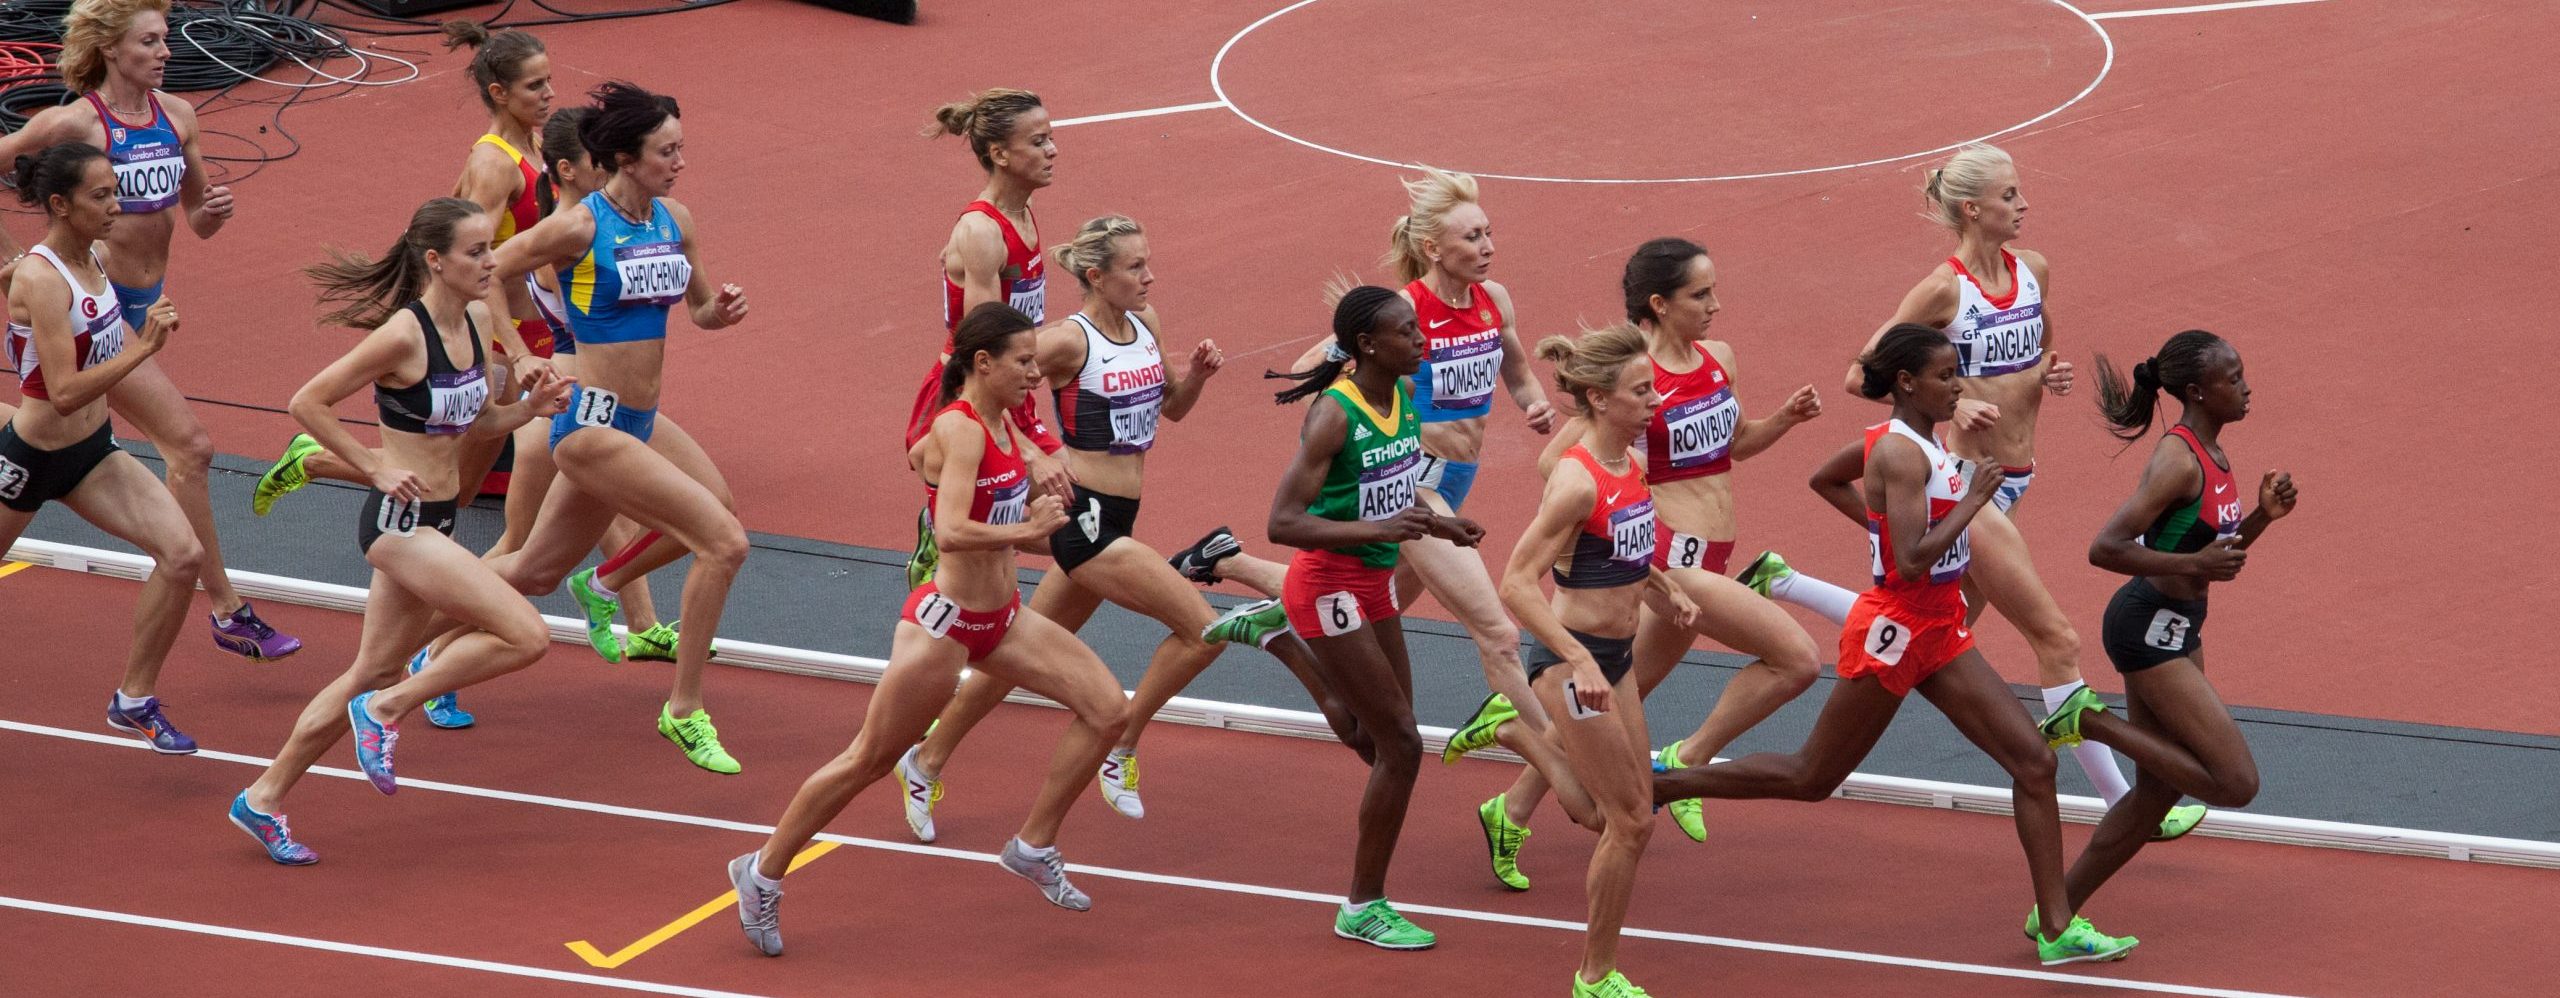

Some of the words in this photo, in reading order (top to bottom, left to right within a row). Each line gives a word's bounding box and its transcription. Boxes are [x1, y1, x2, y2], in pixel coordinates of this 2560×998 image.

[128, 151, 154, 160] London
[155, 148, 170, 157] 2012
[633, 248, 656, 257] London
[657, 245, 672, 253] 2012
[1995, 311, 2019, 324] London
[2020, 307, 2034, 318] 2012
[1452, 346, 1479, 358] London
[1480, 341, 1494, 352] 2012
[584, 391, 615, 425] 13
[1684, 400, 1710, 415] London
[1710, 392, 1722, 405] 2012
[1673, 403, 1738, 454] ROWBURY
[1362, 435, 1421, 468] ETHIOPIA
[1380, 463, 1403, 477] London
[1418, 452, 1437, 482] 7
[385, 496, 415, 533] 16
[1682, 537, 1699, 568] 8
[921, 594, 954, 631] 11
[1332, 597, 1349, 630] 6
[1874, 624, 1898, 654] 9
[2157, 617, 2181, 647] 5
